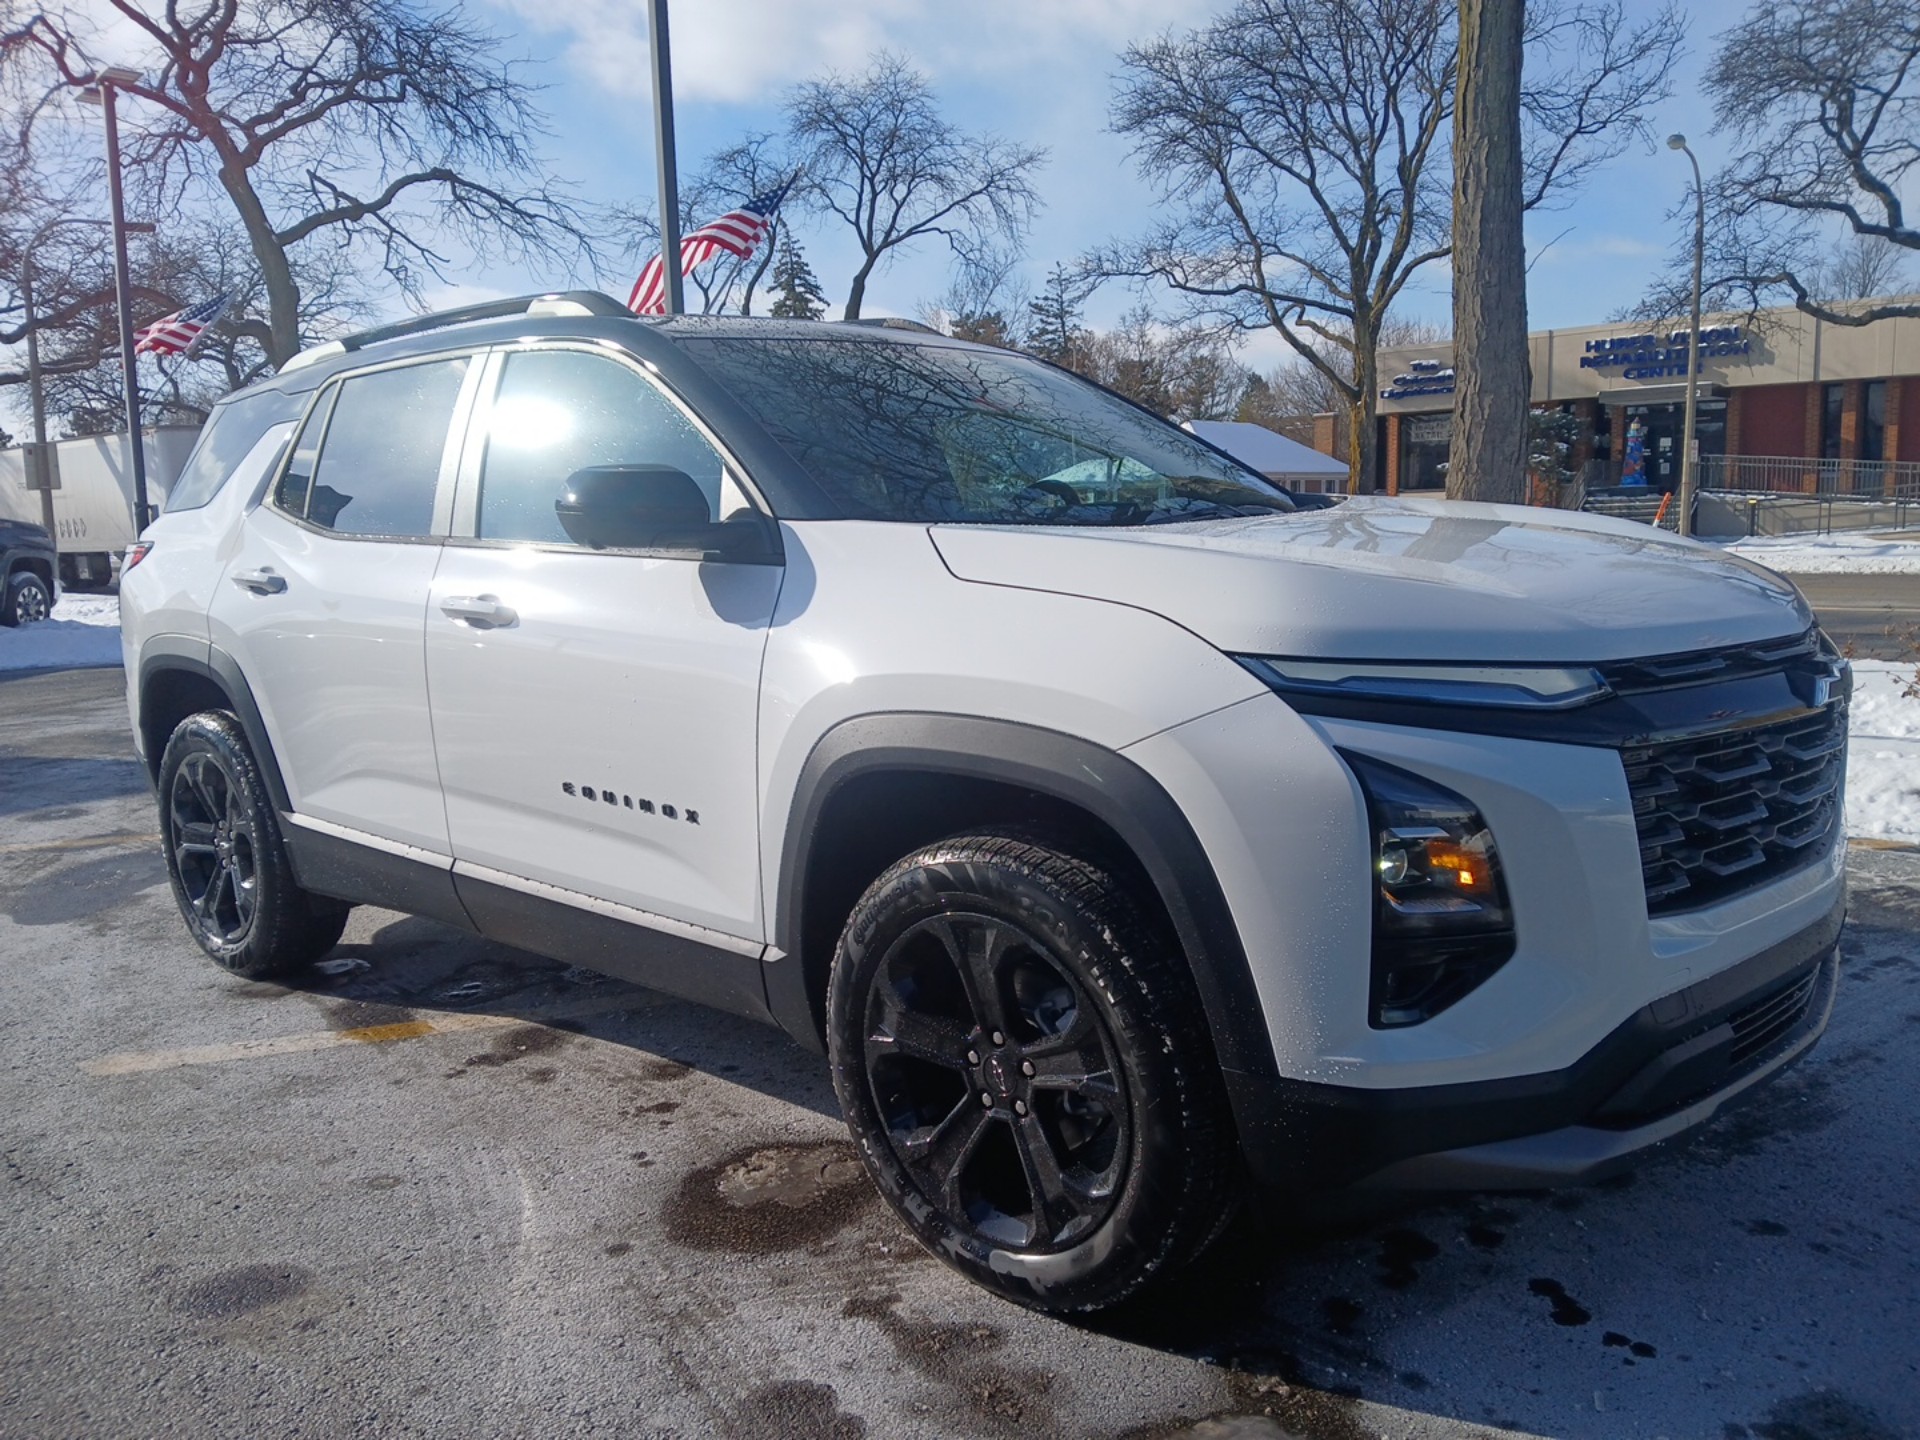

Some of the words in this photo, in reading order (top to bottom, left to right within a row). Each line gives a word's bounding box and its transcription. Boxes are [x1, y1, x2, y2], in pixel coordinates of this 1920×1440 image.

[1585, 335, 1655, 353] HUBER
[1669, 325, 1739, 345] VIION
[1410, 361, 1438, 371] The
[1580, 340, 1748, 368] REHABILITTION
[561, 780, 701, 826] EQUINOX
